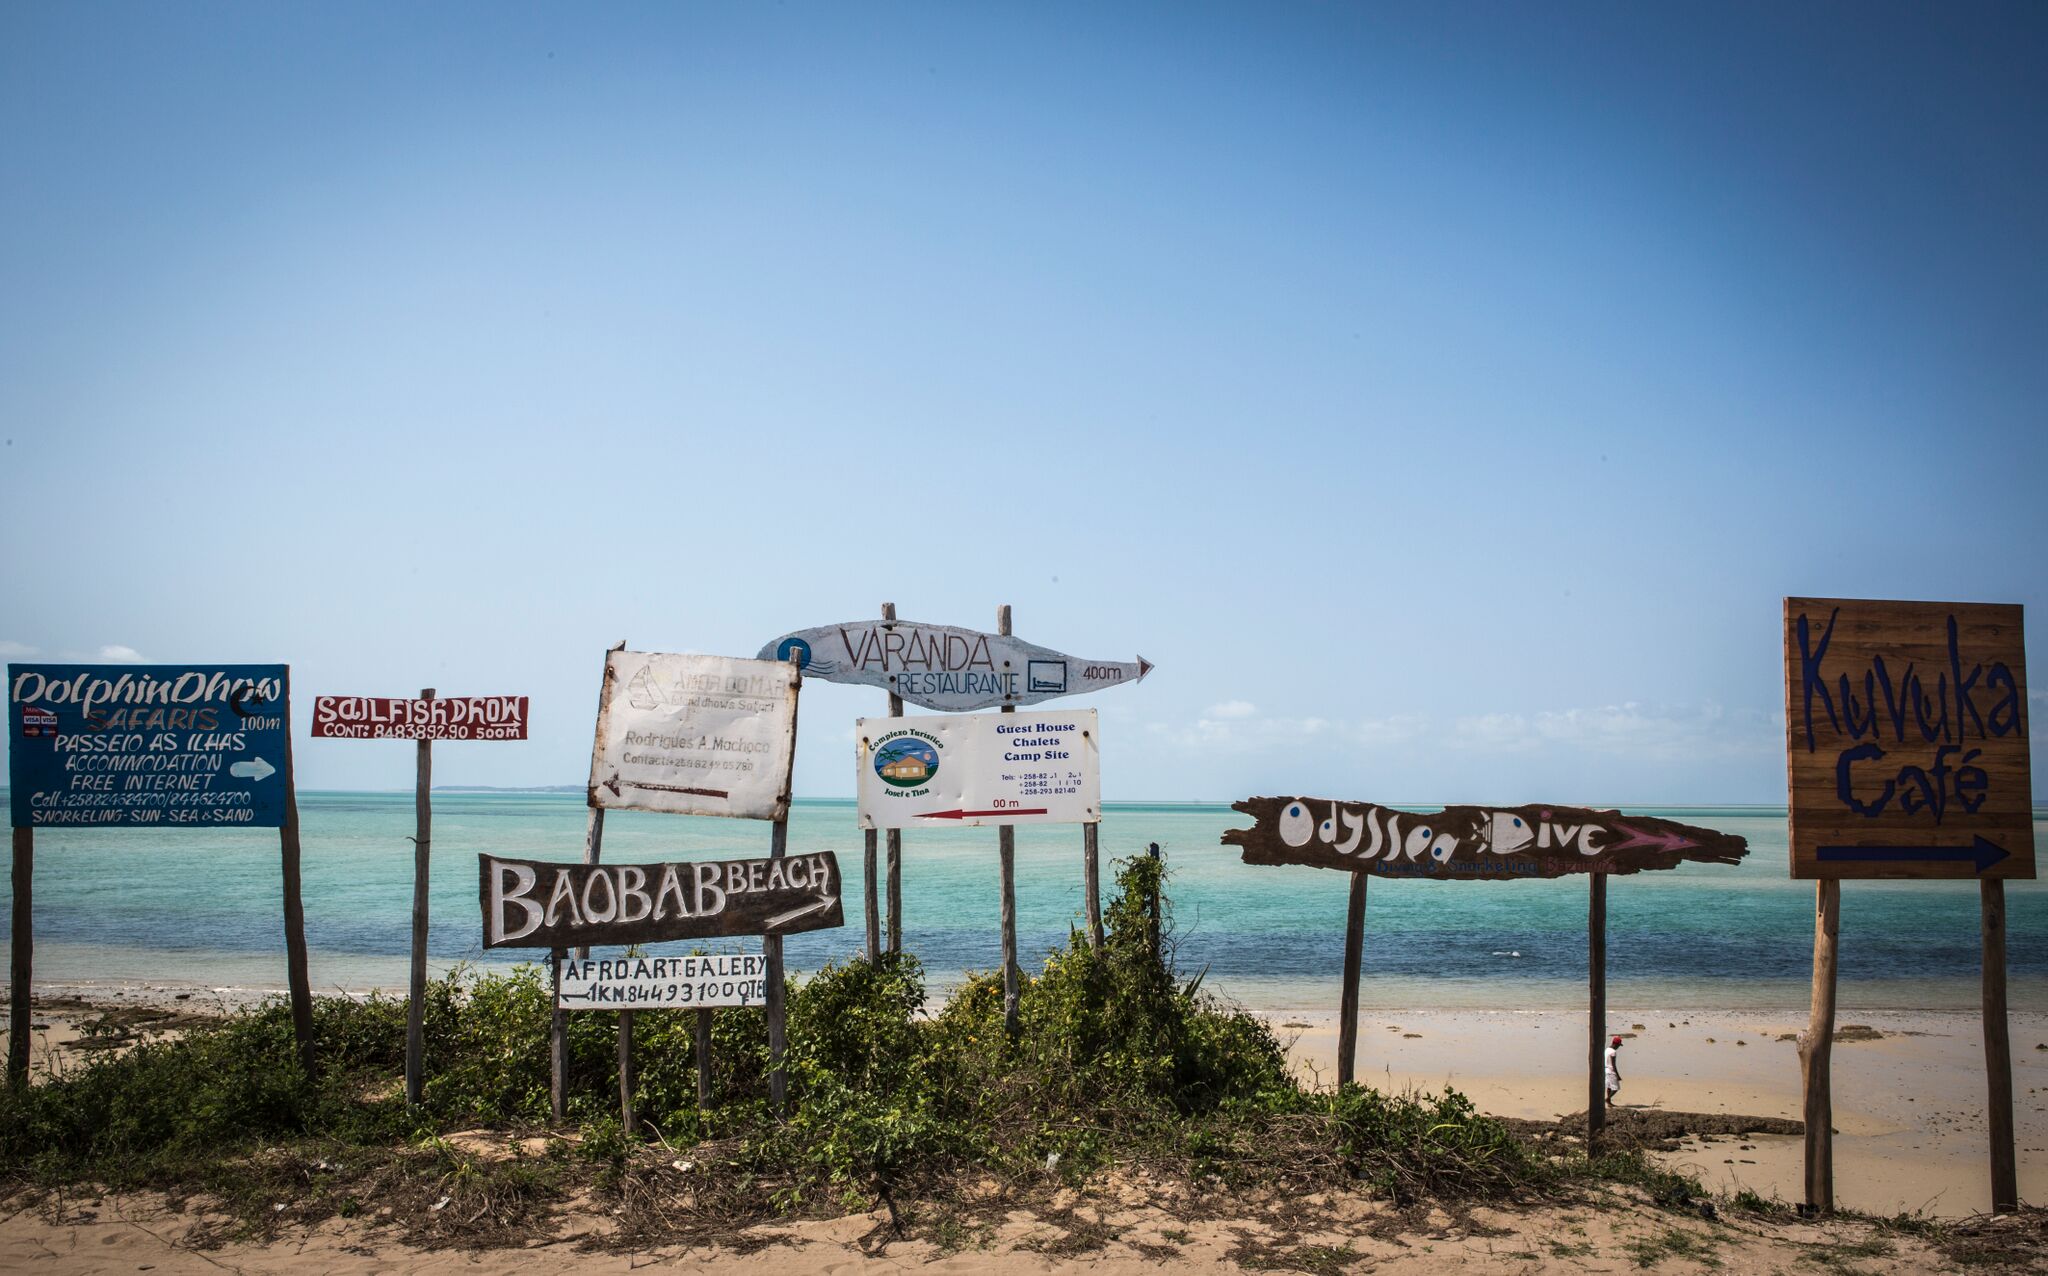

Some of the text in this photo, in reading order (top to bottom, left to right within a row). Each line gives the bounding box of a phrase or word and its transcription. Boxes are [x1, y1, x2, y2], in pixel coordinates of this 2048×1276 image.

[839, 626, 995, 672] VARANDA
[1083, 665, 1122, 681] 400m
[897, 672, 1020, 695] RESTAURANTE
[86, 708, 220, 731] SAFARIS
[239, 716, 281, 731] 100m
[323, 722, 368, 737] CONT:
[476, 728, 520, 739] 500m
[996, 724, 1075, 734] Guest House
[54, 733, 247, 752] PASSEIO AS ILHAS
[625, 731, 694, 749] Rodrigues
[868, 730, 908, 751] Complexo
[1013, 738, 1060, 747] Chalets
[65, 754, 222, 771] ACCOMMODATION
[1004, 751, 1070, 761] Camp Site
[71, 774, 215, 791] FREE INTERNET
[1837, 743, 1989, 825] Café
[911, 788, 930, 797] Tina
[1009, 800, 1019, 808] m
[169, 809, 199, 822] SEA
[202, 810, 212, 821] &
[213, 808, 254, 822] SAND
[1279, 800, 1607, 865] Odyssea Dive
[1449, 857, 1538, 875] Snorkeling
[491, 853, 829, 945] BAOBAB BEACH
